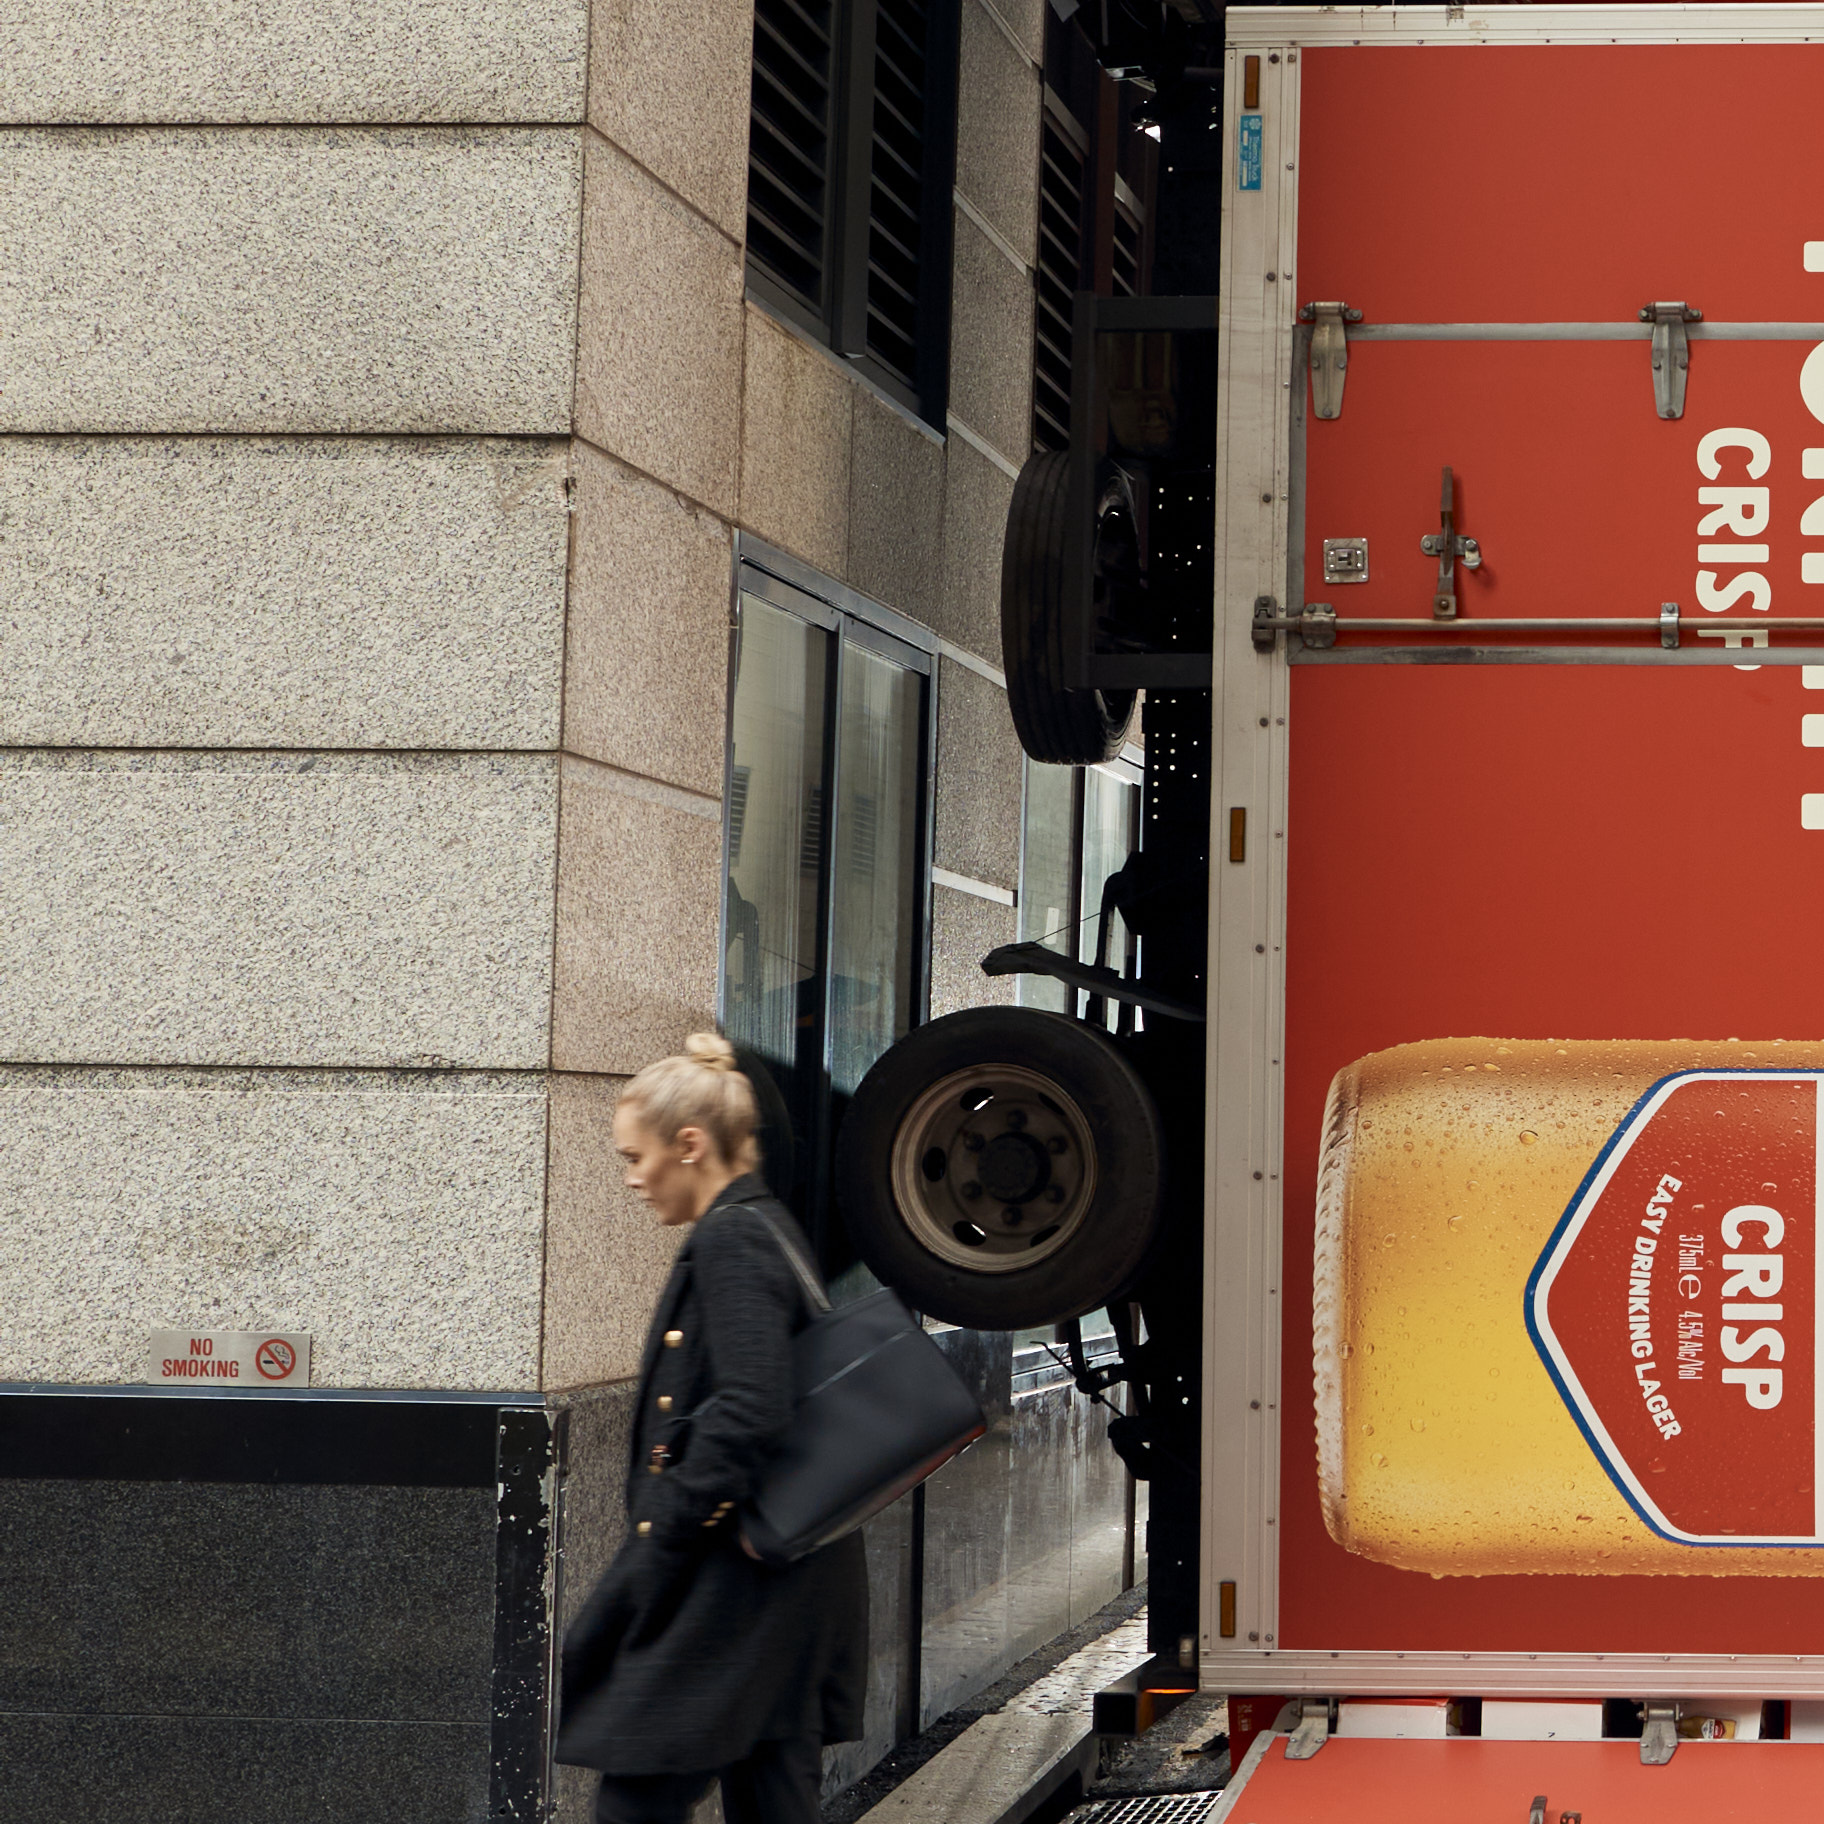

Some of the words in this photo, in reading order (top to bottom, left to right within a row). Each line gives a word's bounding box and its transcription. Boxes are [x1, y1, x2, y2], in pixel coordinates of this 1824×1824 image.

[1640, 1173, 1683, 1234] EASY
[1678, 1234, 1704, 1273] 375mL
[1628, 1236, 1657, 1359] DRINKING
[1721, 1204, 1785, 1410] CRISP
[1678, 1311, 1704, 1339] 4.5%
[190, 1338, 213, 1356] NO
[1676, 1340, 1705, 1380] Alc/Vol
[162, 1359, 239, 1378] SMOKING
[1634, 1361, 1682, 1441] LAGER
